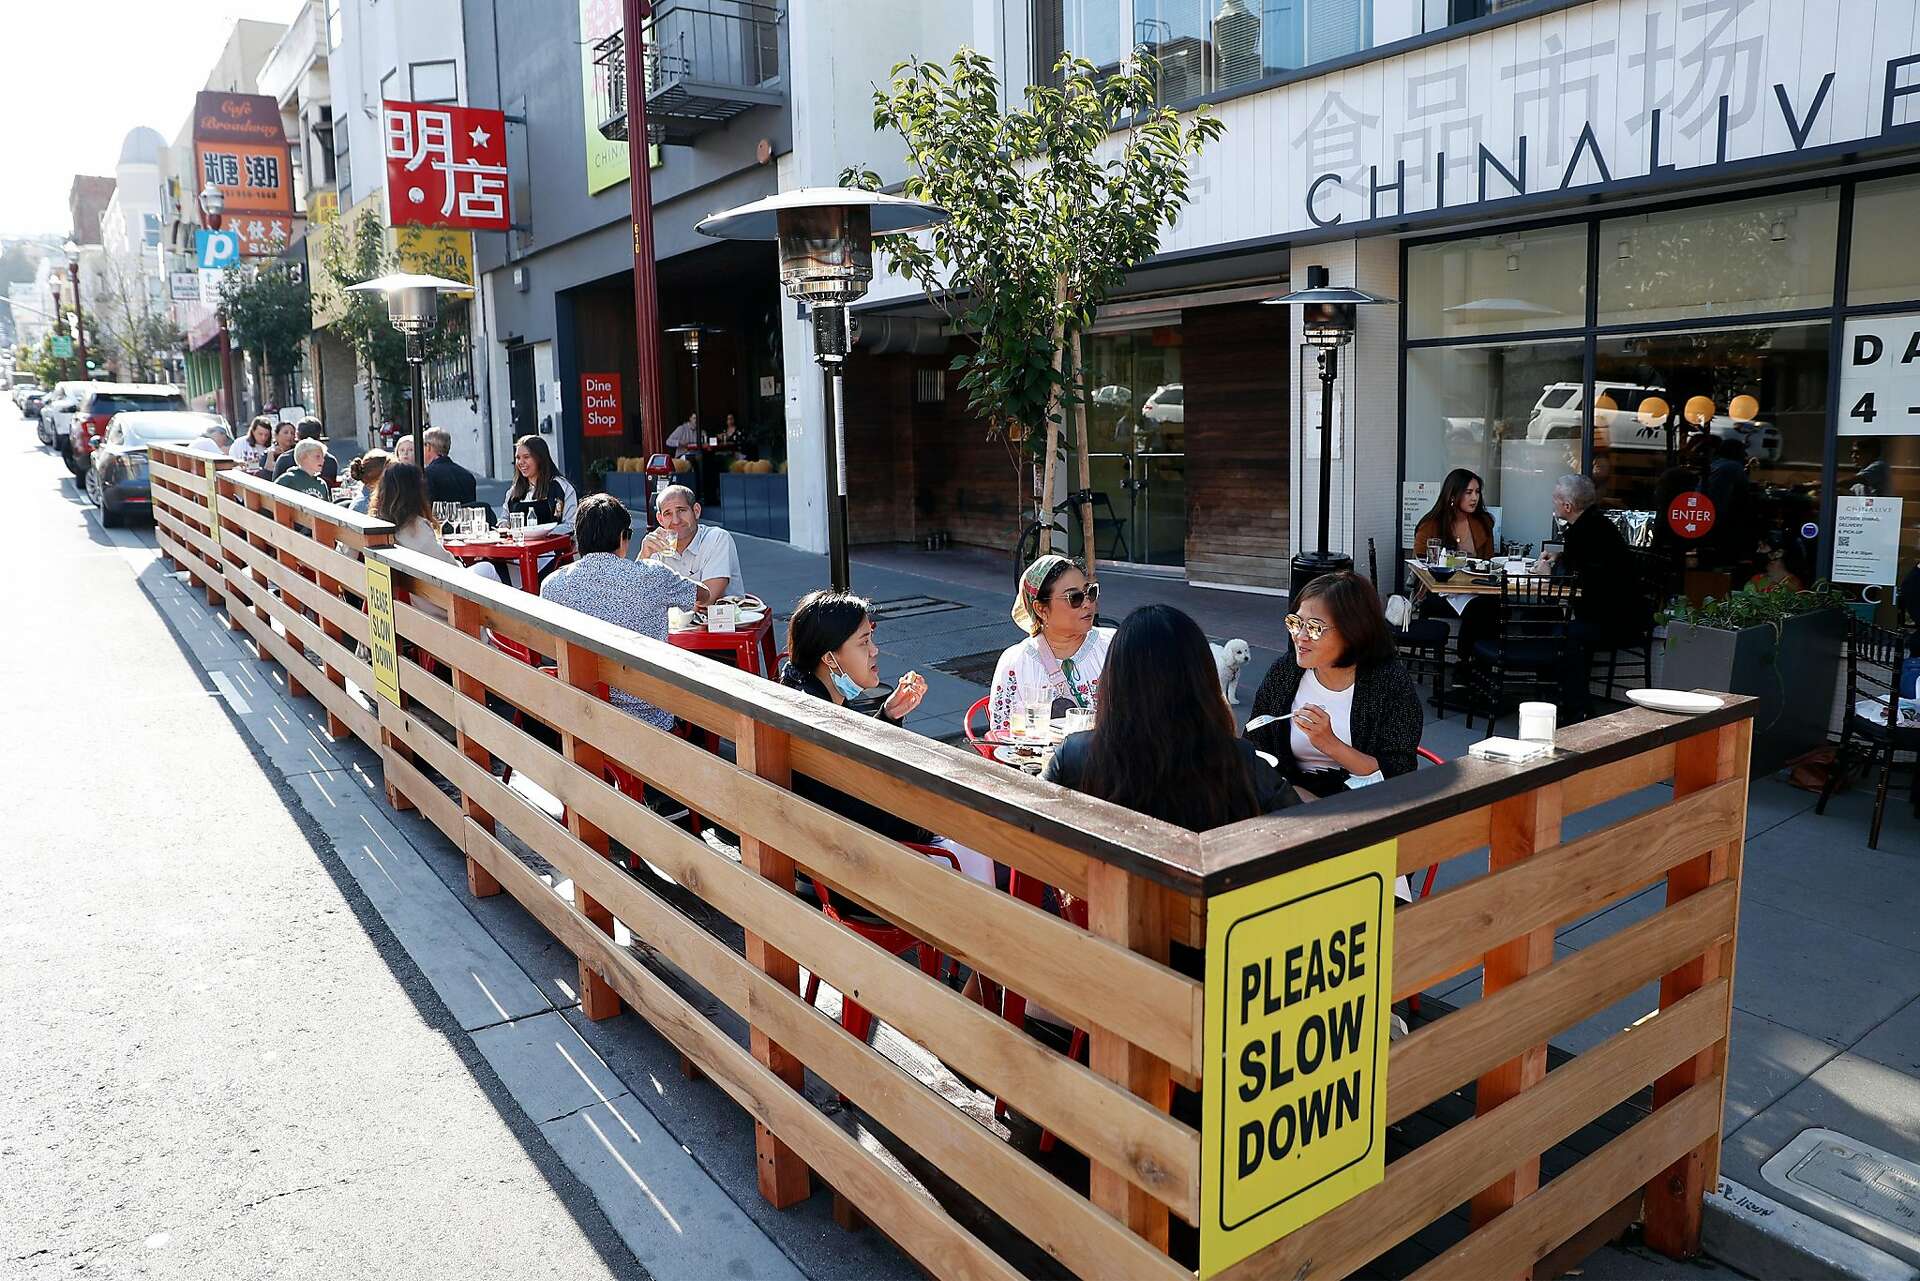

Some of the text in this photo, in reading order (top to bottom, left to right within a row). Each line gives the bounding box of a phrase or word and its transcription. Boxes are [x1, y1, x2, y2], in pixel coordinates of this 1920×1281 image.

[1292, 0, 1764, 201] 食品市场
[200, 115, 278, 137] Broadway
[384, 110, 507, 219] 明店
[586, 379, 612, 391] Dine
[587, 394, 616, 408] Drink
[1849, 392, 1878, 423] 4
[588, 411, 616, 428] Shop
[1671, 509, 1711, 521] ENTER
[370, 585, 389, 615] PLEASE
[372, 614, 391, 645] SLOW
[374, 642, 394, 673] DOWN
[1240, 920, 1367, 1026] PLEASE
[1237, 994, 1366, 1103] SLOW
[1237, 1069, 1362, 1181] DOWN
